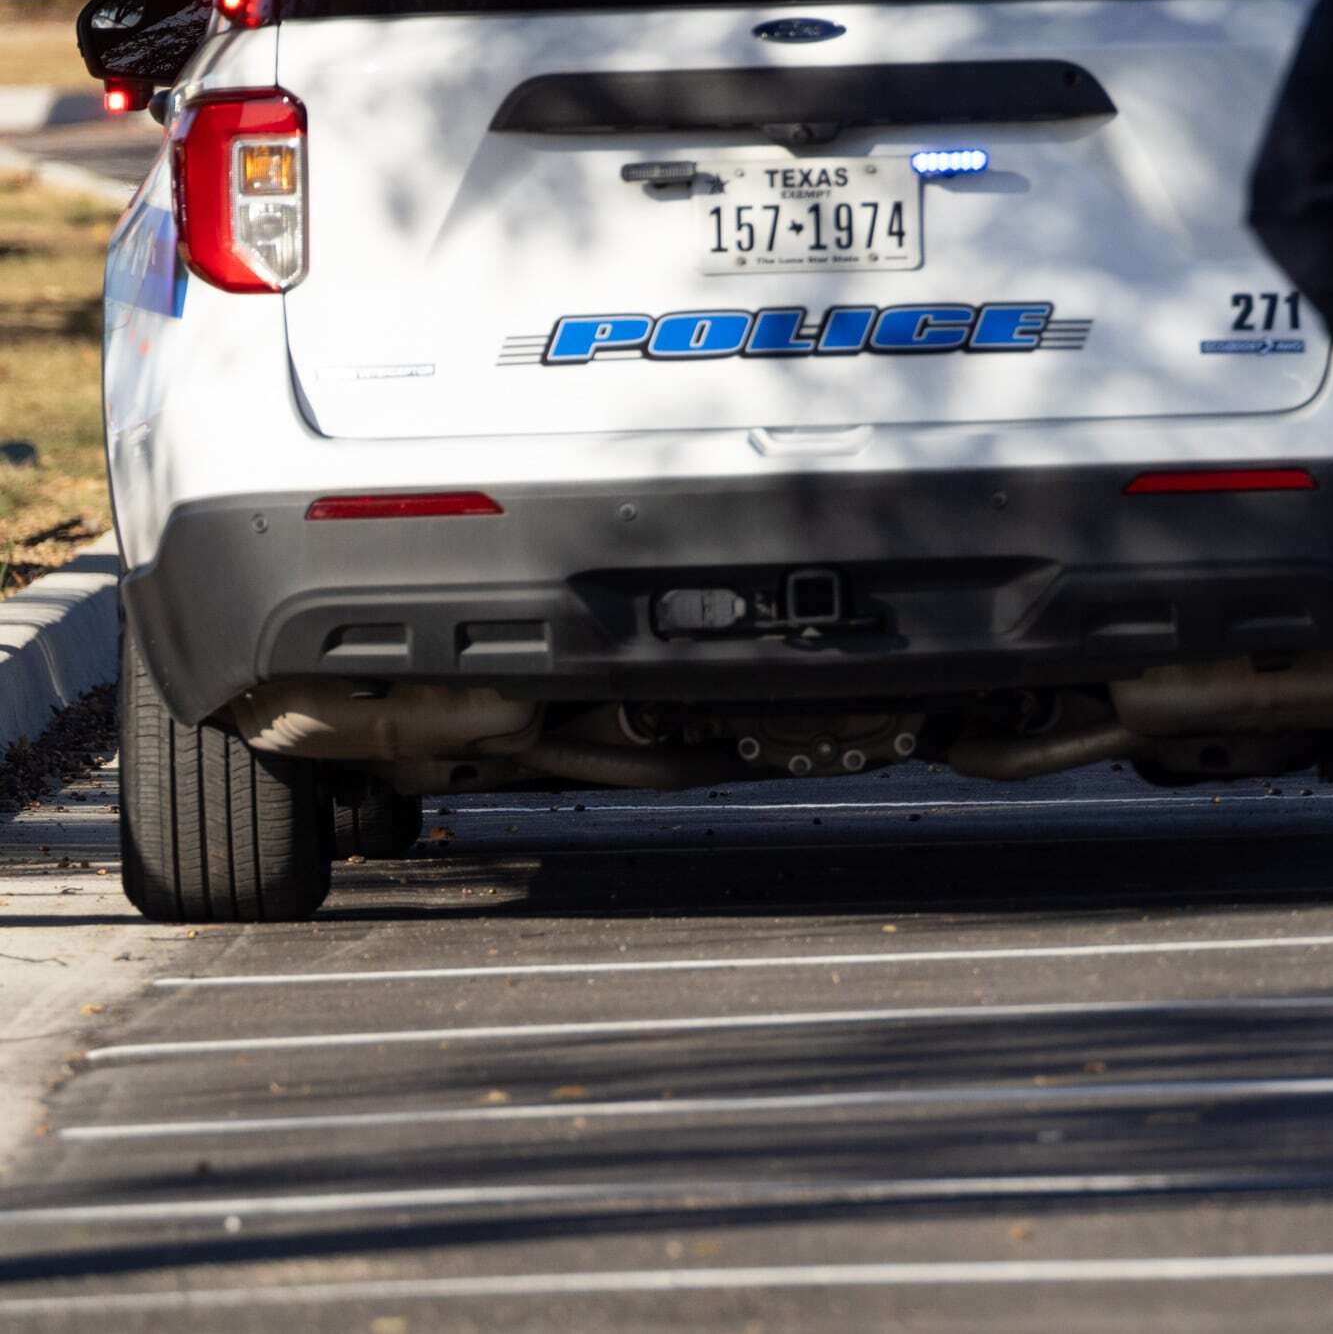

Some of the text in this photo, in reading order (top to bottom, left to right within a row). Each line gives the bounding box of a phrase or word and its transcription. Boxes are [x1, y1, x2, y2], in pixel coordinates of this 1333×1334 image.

[764, 168, 848, 188] TEXAS
[709, 201, 905, 252] 157 1974
[541, 302, 1053, 365] POLICE
[1231, 292, 1300, 331] 271
